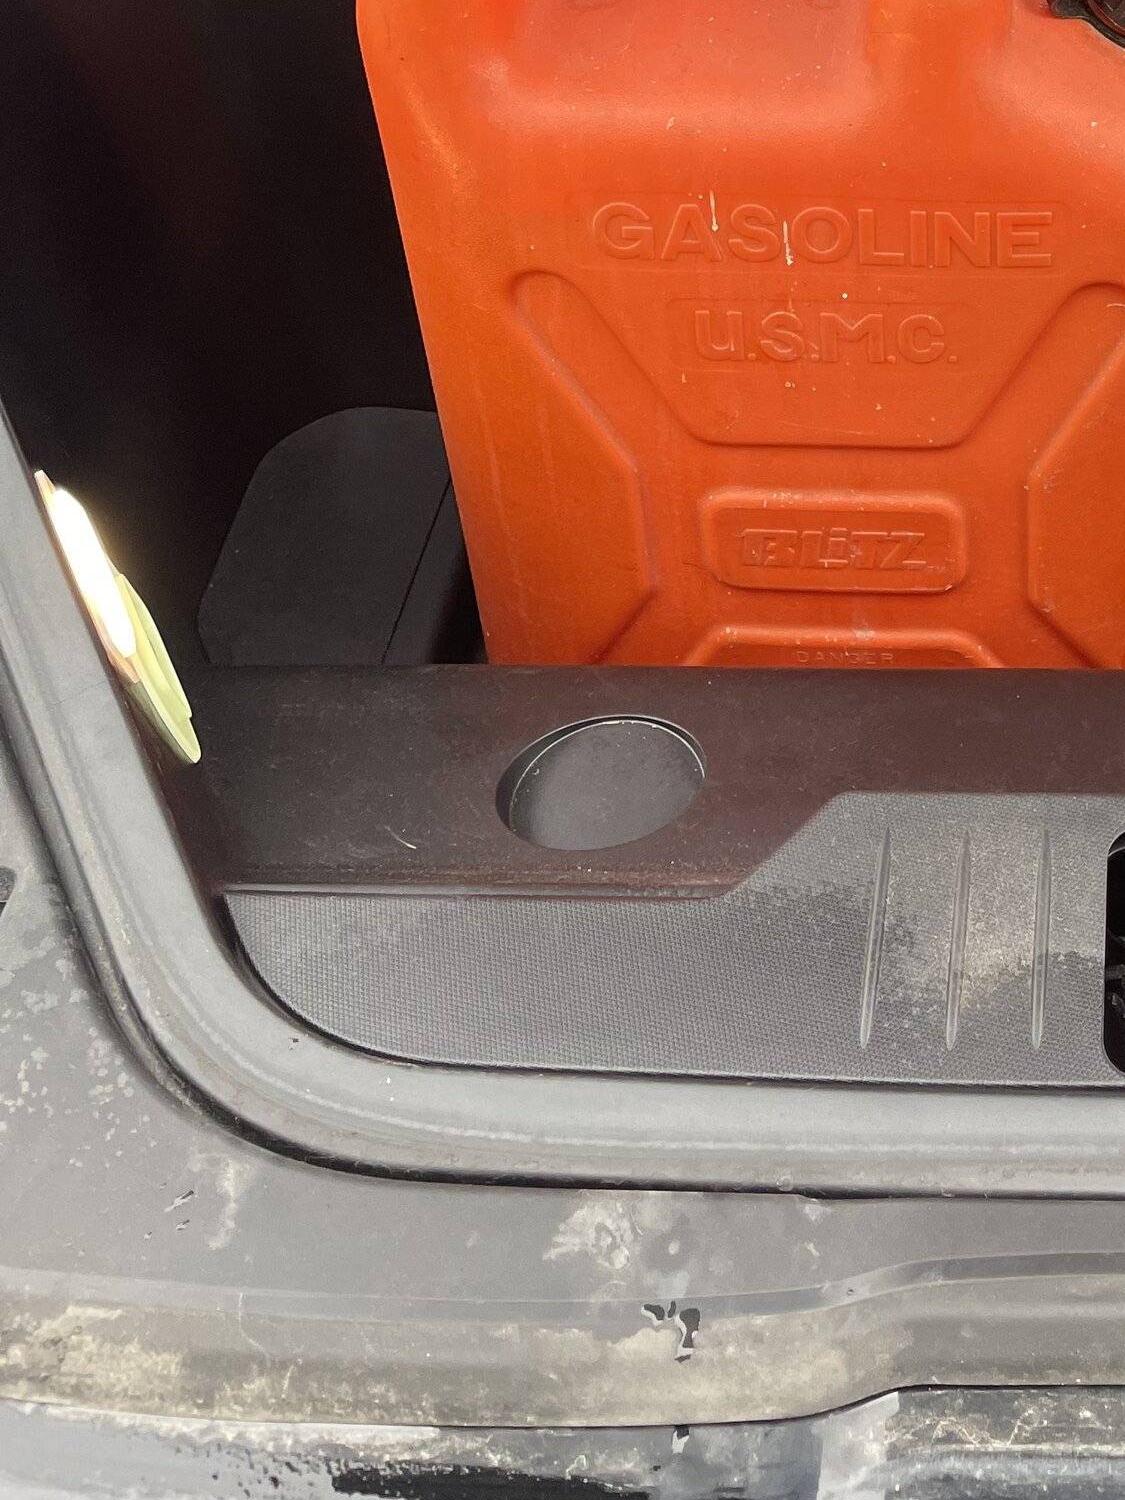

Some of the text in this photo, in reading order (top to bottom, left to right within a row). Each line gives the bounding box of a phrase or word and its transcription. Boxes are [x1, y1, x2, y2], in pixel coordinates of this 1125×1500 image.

[592, 200, 1054, 269] GASOLINE
[694, 308, 959, 365] U.S.M.C.
[740, 527, 928, 570] BLITZ
